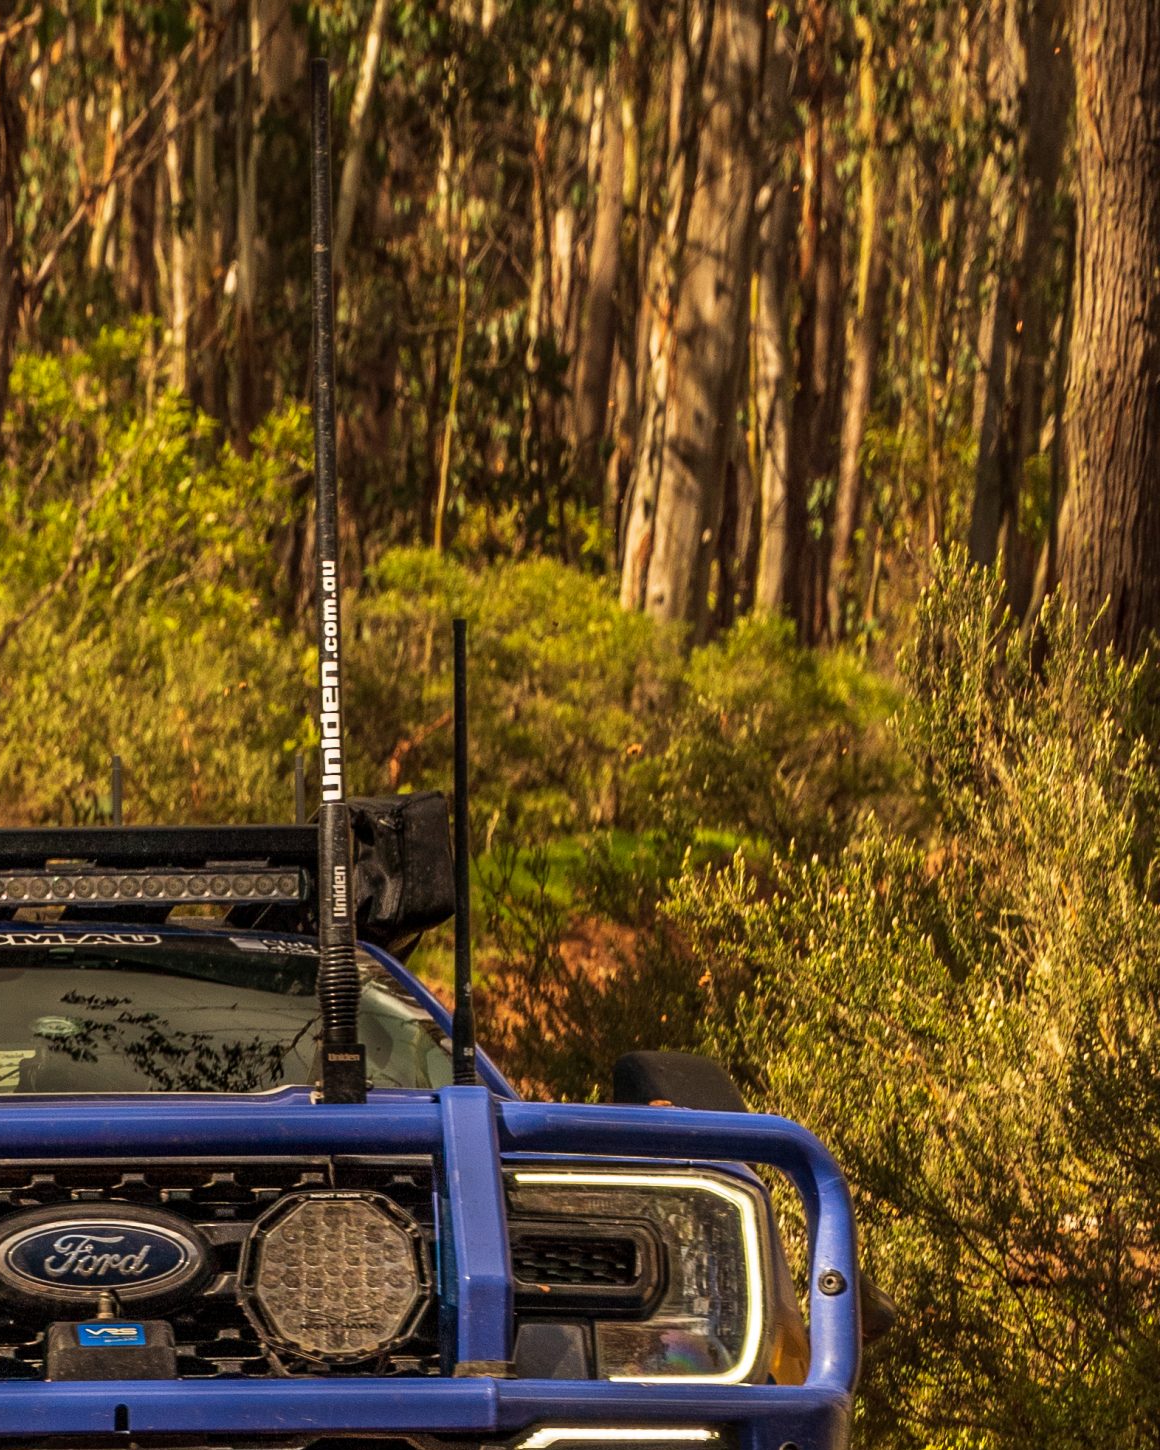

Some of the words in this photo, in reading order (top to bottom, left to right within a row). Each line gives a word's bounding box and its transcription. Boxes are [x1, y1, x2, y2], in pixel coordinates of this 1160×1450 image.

[332, 866, 347, 917] Uniden
[44, 1234, 151, 1277] Ford
[85, 1327, 138, 1336] VRS
